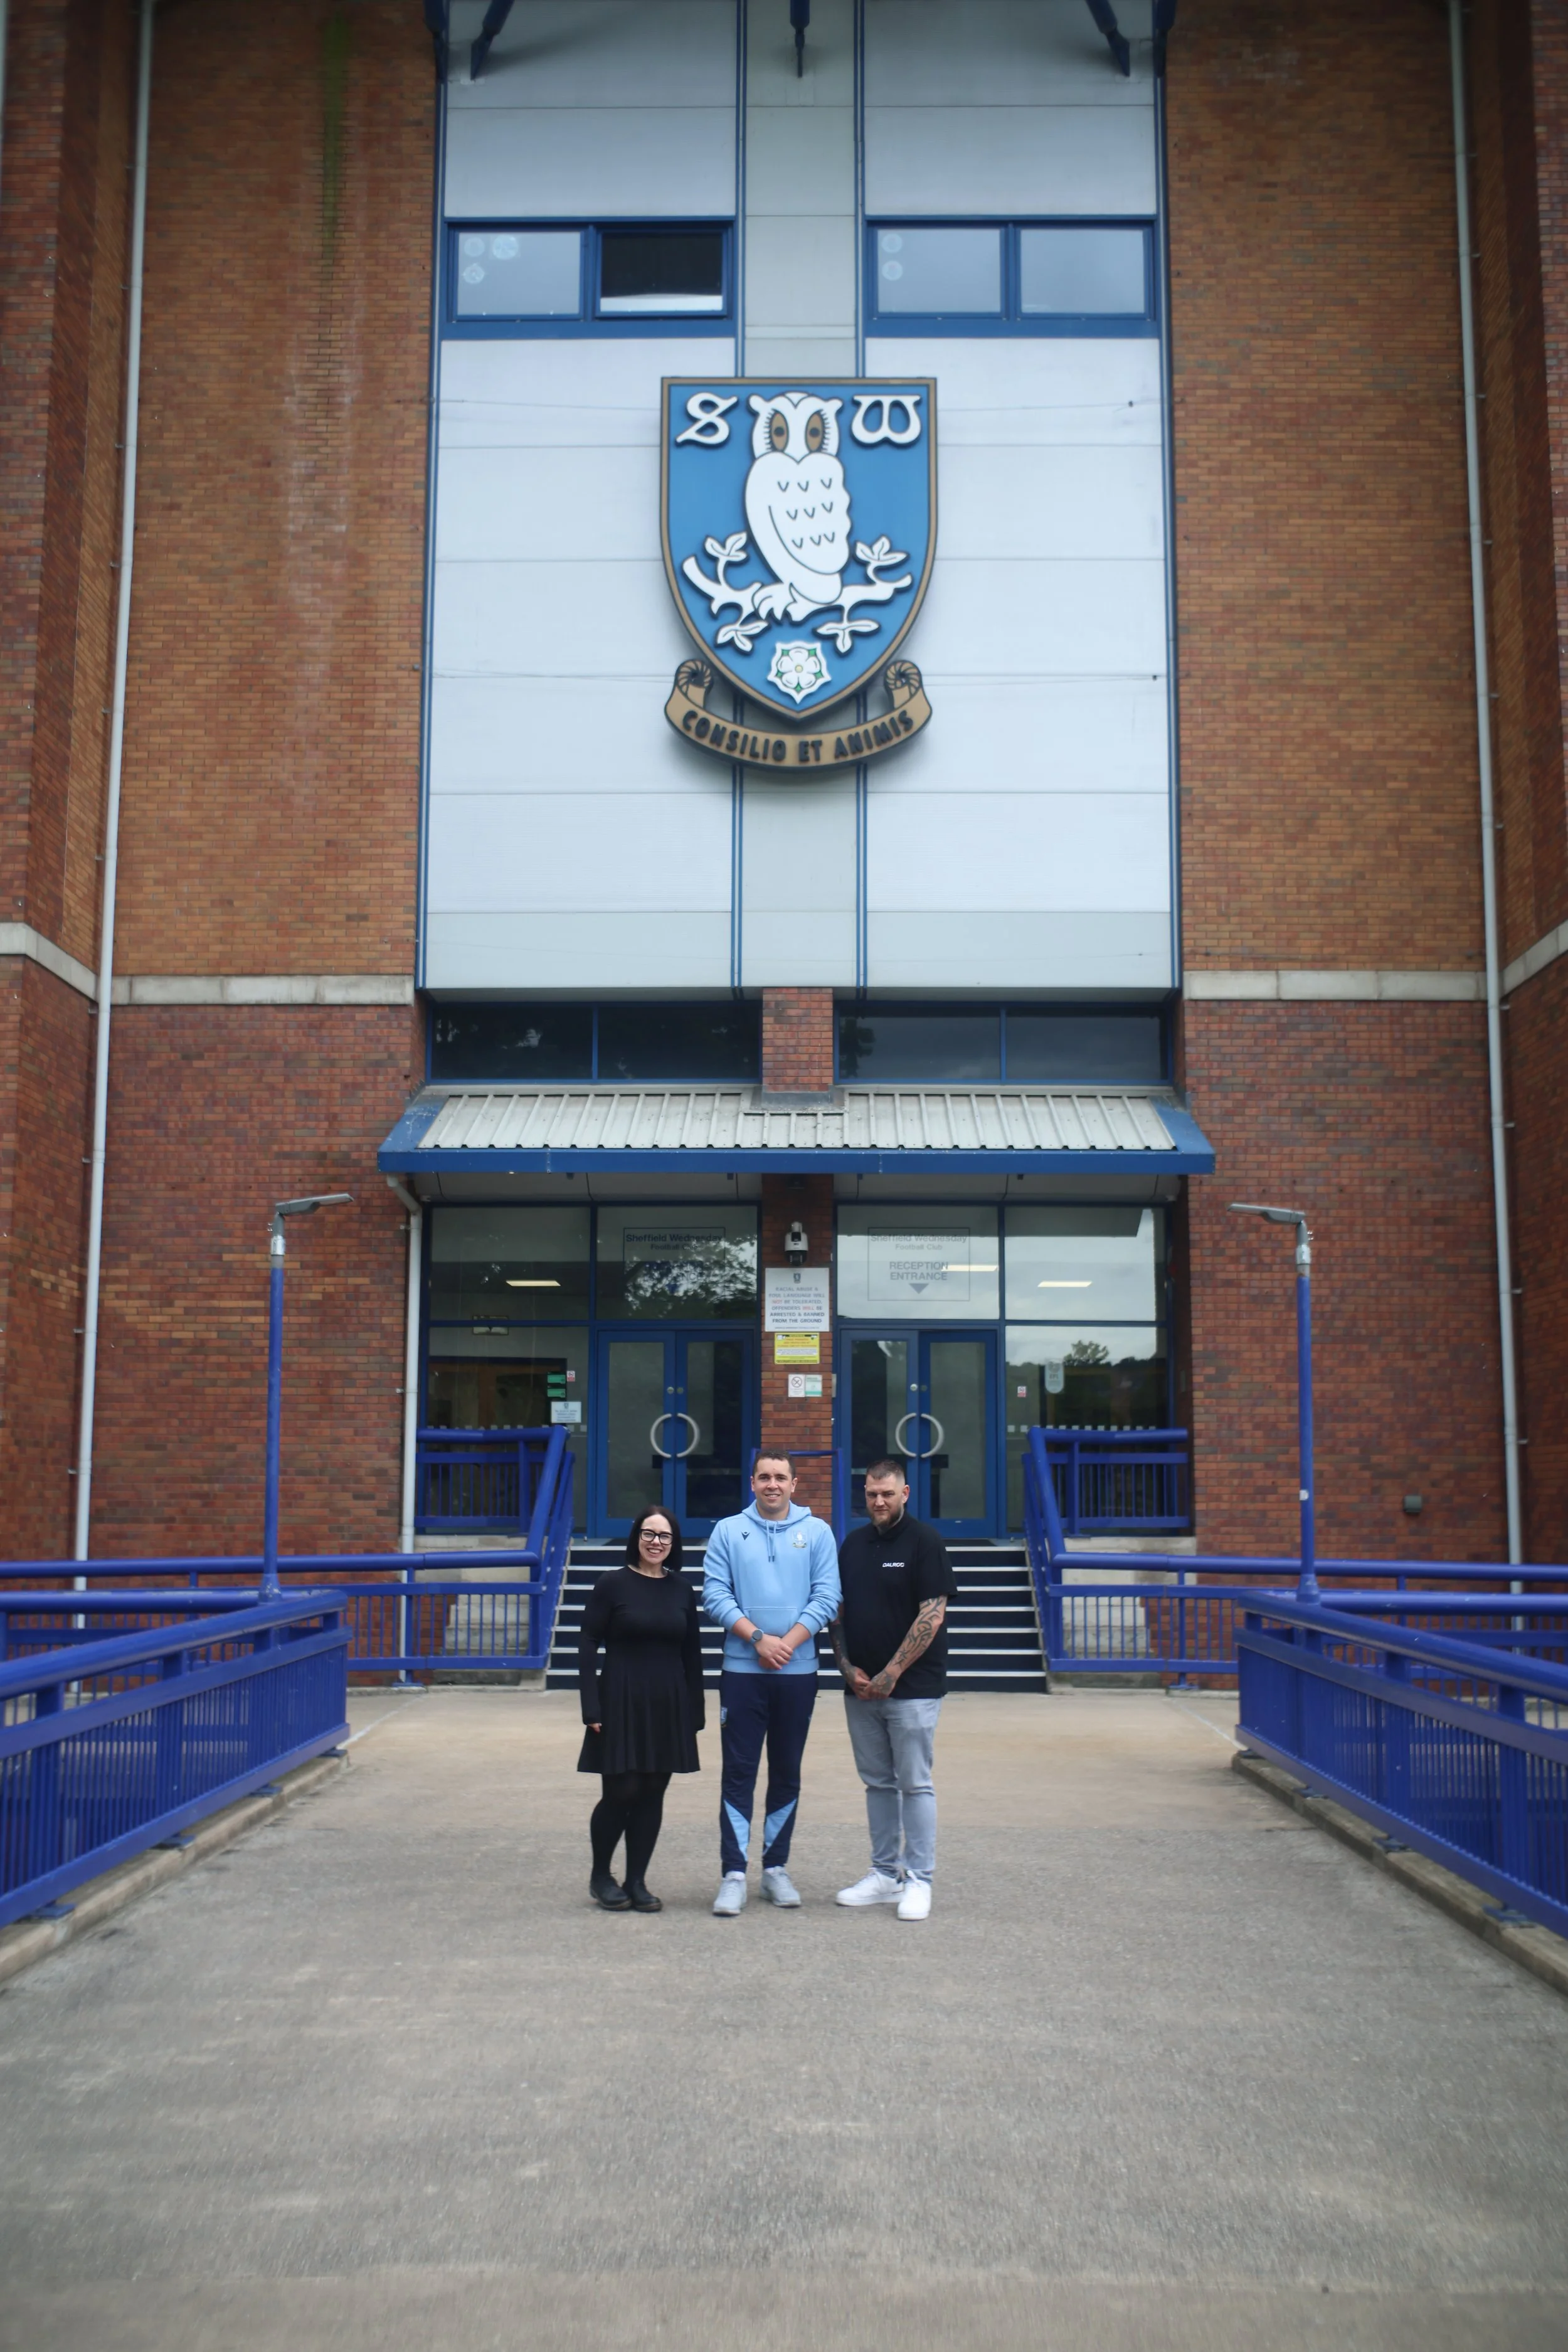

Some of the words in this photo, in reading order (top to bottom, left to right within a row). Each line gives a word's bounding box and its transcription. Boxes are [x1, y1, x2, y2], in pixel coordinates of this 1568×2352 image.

[675, 391, 739, 446] S
[682, 710, 787, 762] CONSILIO
[798, 740, 823, 763] ET
[835, 709, 914, 759] ANIMIS
[626, 1234, 667, 1242] Sheffield
[871, 1234, 911, 1242] Sheffield
[914, 1234, 967, 1243] Wednesday
[889, 1261, 948, 1270] RECEPTION
[889, 1272, 948, 1281] ENTRANCE
